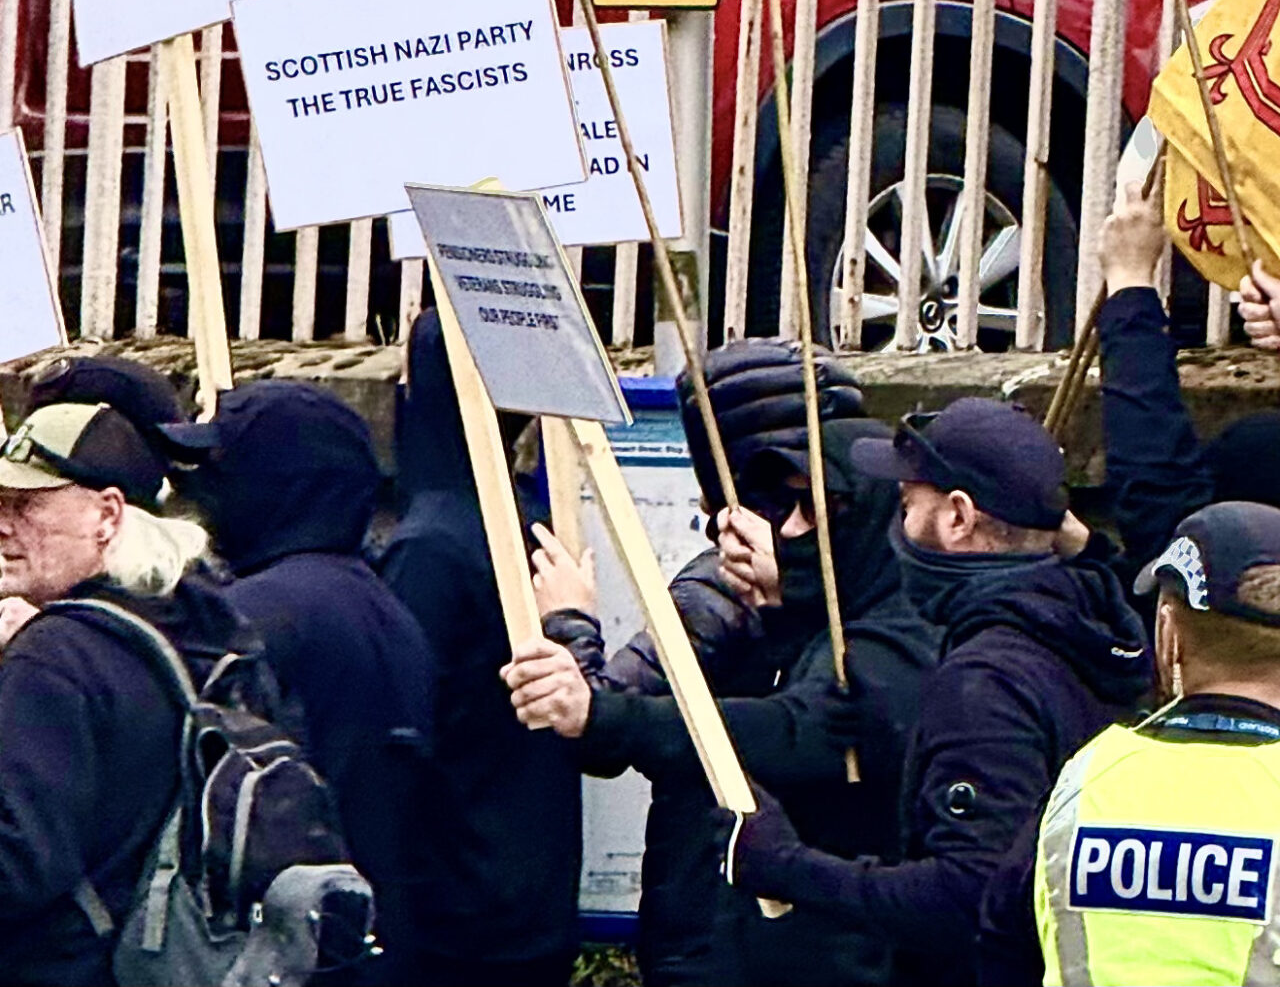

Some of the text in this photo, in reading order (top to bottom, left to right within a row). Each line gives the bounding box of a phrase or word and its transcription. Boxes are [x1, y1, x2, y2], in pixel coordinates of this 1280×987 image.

[265, 20, 533, 81] SCOTTISH NAZI PARTY
[567, 49, 639, 71] NROSS
[286, 62, 528, 118] THE TRUE FASCISTS
[581, 121, 617, 140] ALE
[590, 157, 620, 175] AD
[543, 194, 576, 213] ME
[1077, 838, 1264, 908] POLICE
